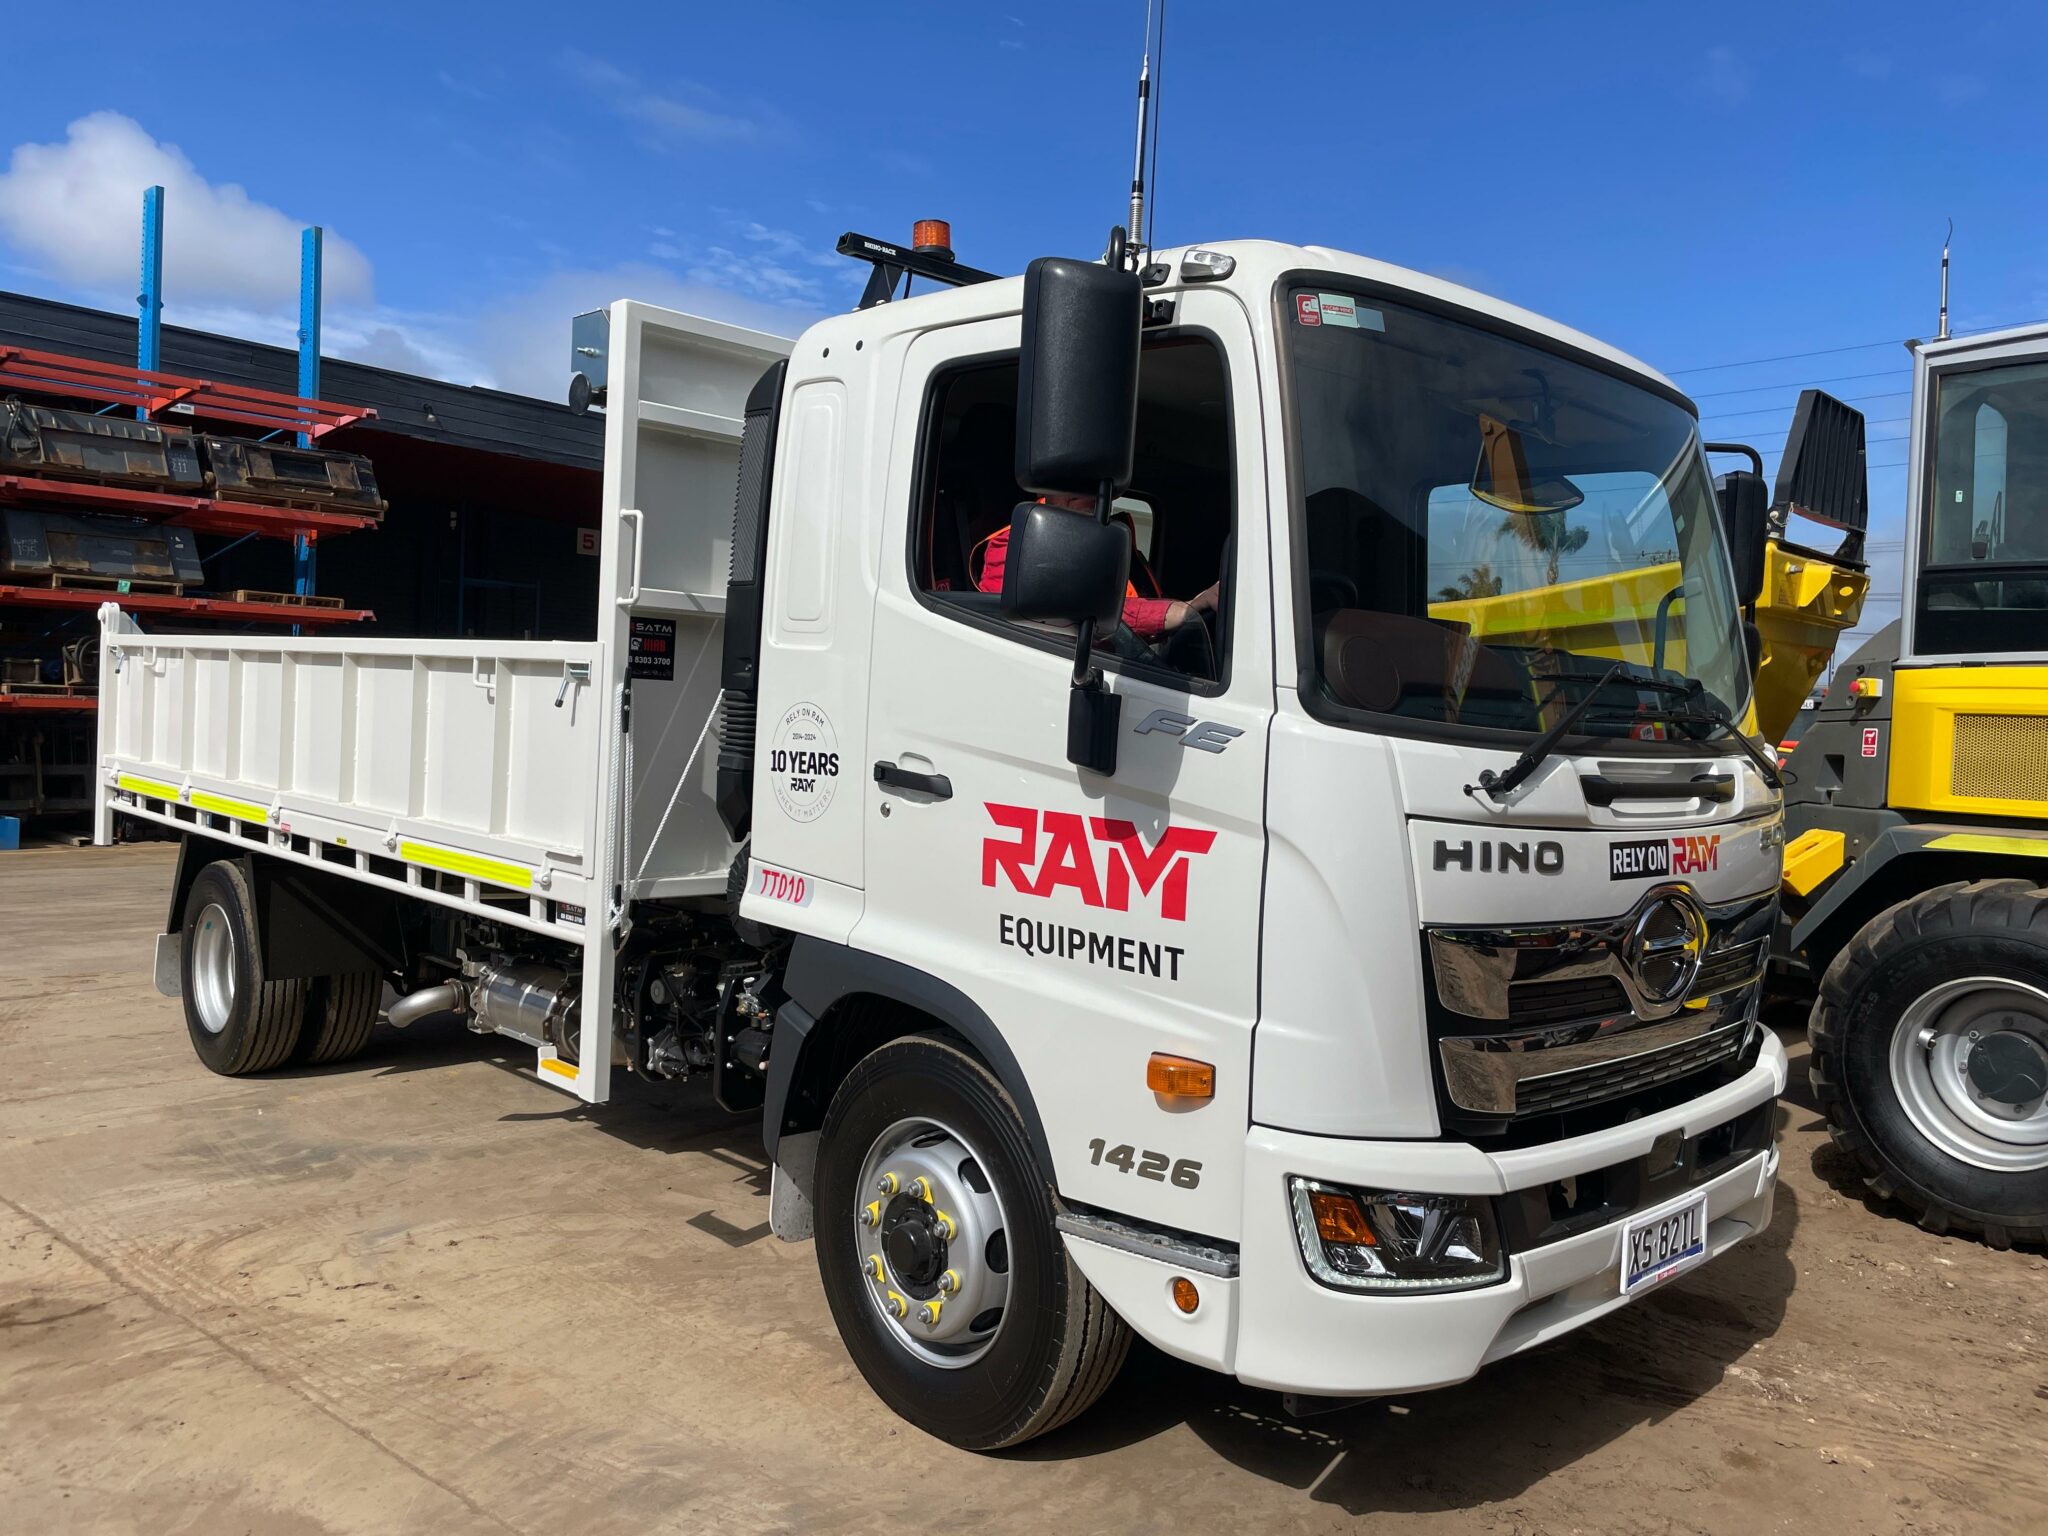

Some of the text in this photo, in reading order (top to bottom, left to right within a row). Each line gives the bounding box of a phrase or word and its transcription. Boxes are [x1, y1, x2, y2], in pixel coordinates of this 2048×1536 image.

[583, 533, 595, 550] 5
[636, 623, 673, 633] SATM
[634, 656, 652, 664] 8303
[653, 657, 671, 666] 3700
[785, 708, 825, 727] RELY ON RAM
[1133, 709, 1246, 754] FE
[792, 733, 817, 741] 2014-2024
[771, 750, 839, 777] 10 YEARS
[790, 777, 816, 793] RAM
[795, 808, 801, 817] IT
[804, 789, 831, 818] MATTERS
[982, 802, 1218, 922] RAM
[1433, 840, 1564, 876] HINO
[1613, 834, 1721, 875] RELY ON RAM
[1000, 913, 1185, 981] EQUIPMENT
[1088, 1137, 1203, 1190] 1426
